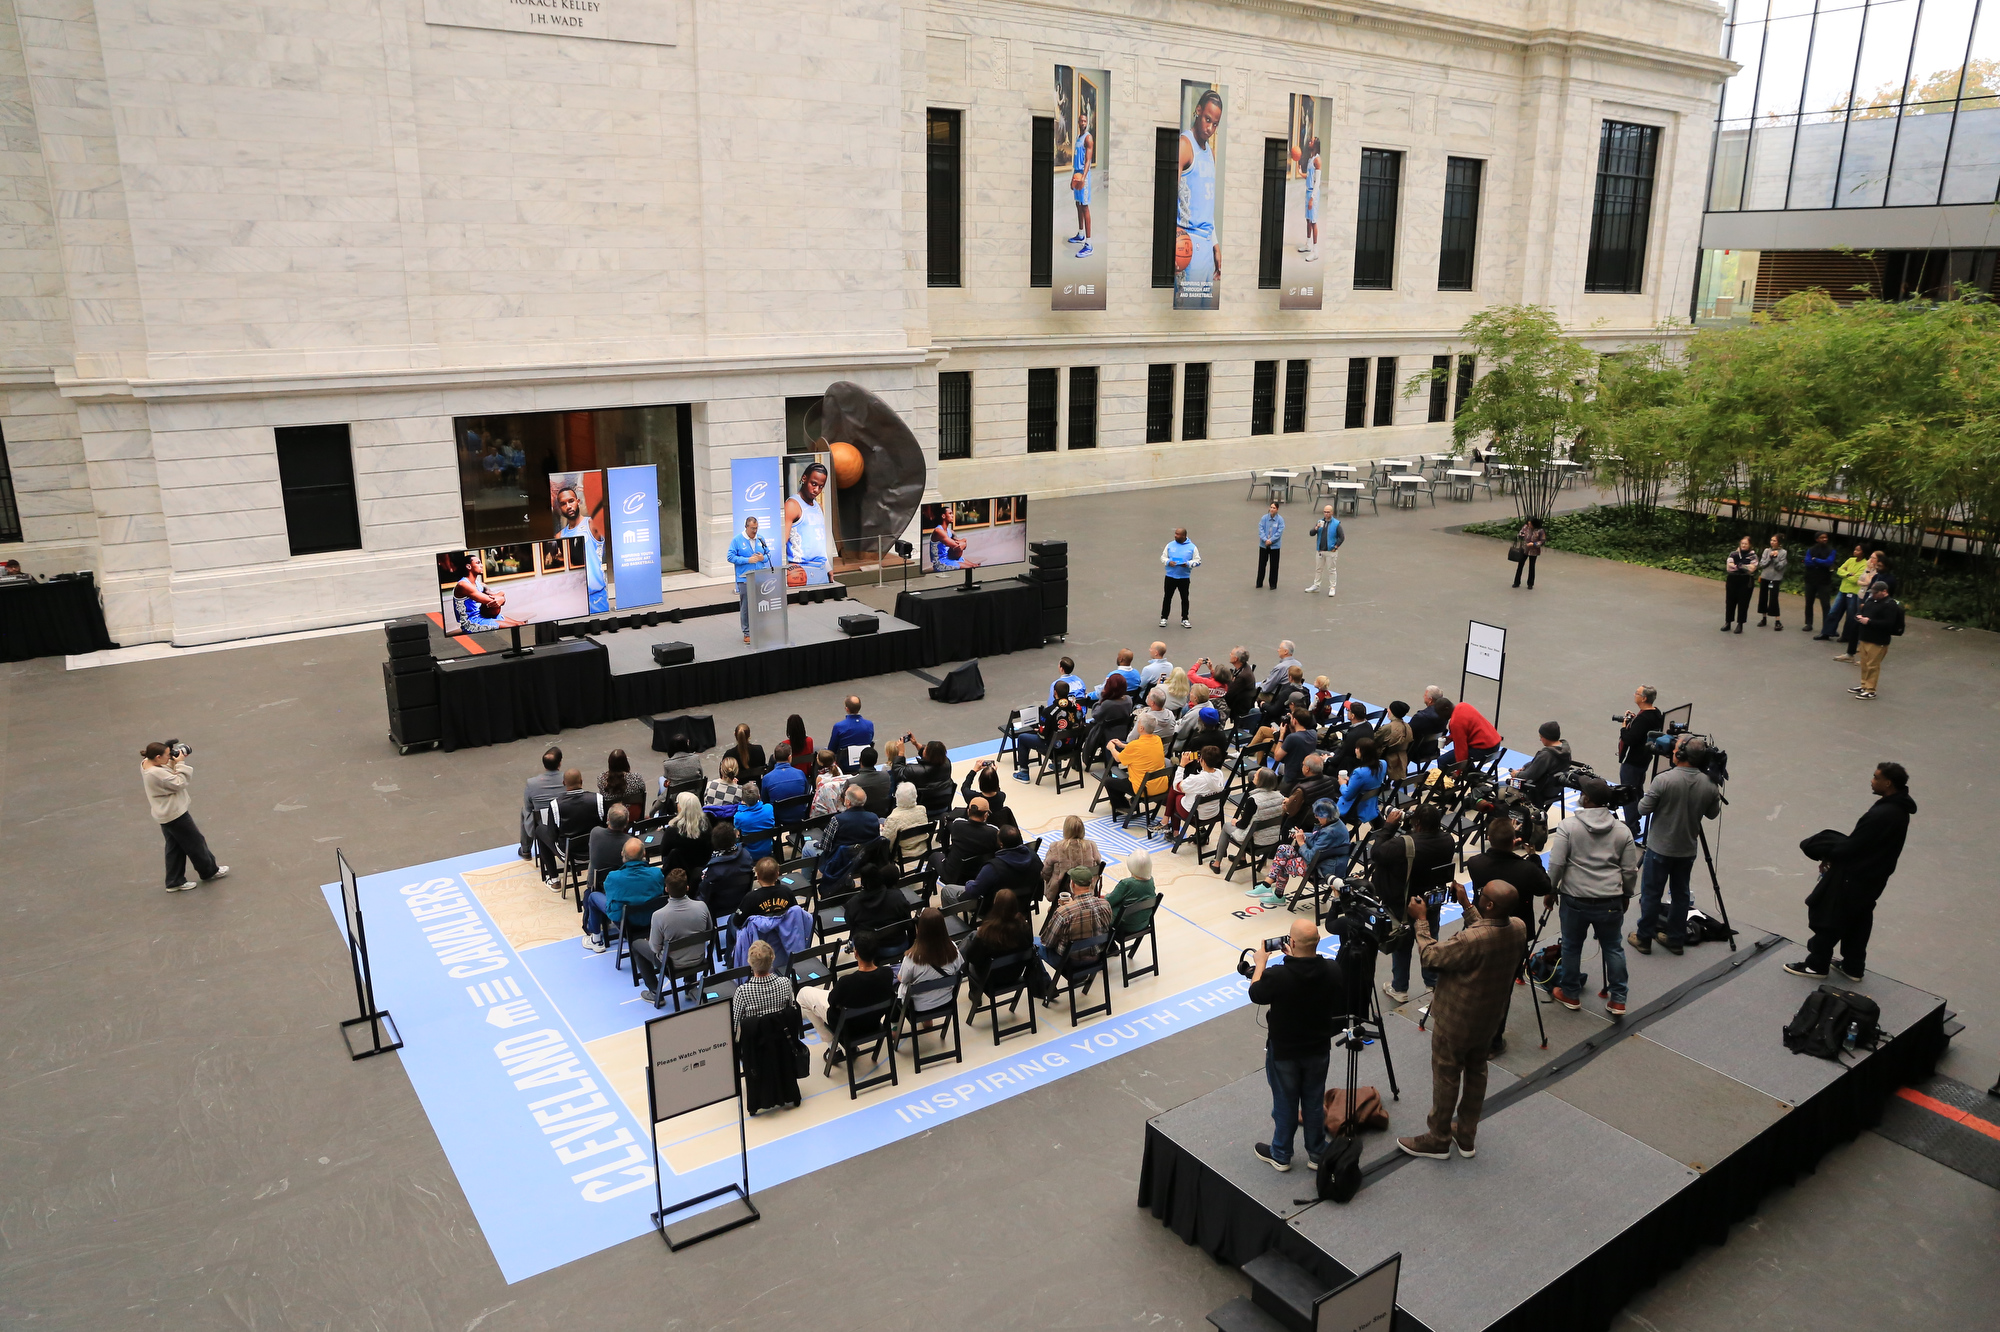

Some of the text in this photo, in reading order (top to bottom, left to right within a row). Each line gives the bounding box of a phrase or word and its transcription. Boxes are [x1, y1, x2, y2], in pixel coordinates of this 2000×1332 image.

[561, 0, 600, 12] KELLEY
[551, 14, 583, 27] WADE
[759, 899, 772, 911] THE
[772, 897, 789, 908] LAND
[399, 877, 510, 979] CAVALIERS
[656, 1057, 678, 1067] Please
[678, 1050, 697, 1060] Watch
[698, 1046, 712, 1054] Your
[894, 979, 1251, 1123] INSPIRING YOUTH THRO
[493, 1028, 657, 1203] CLEVELAND
[1359, 1321, 1372, 1331] Your
